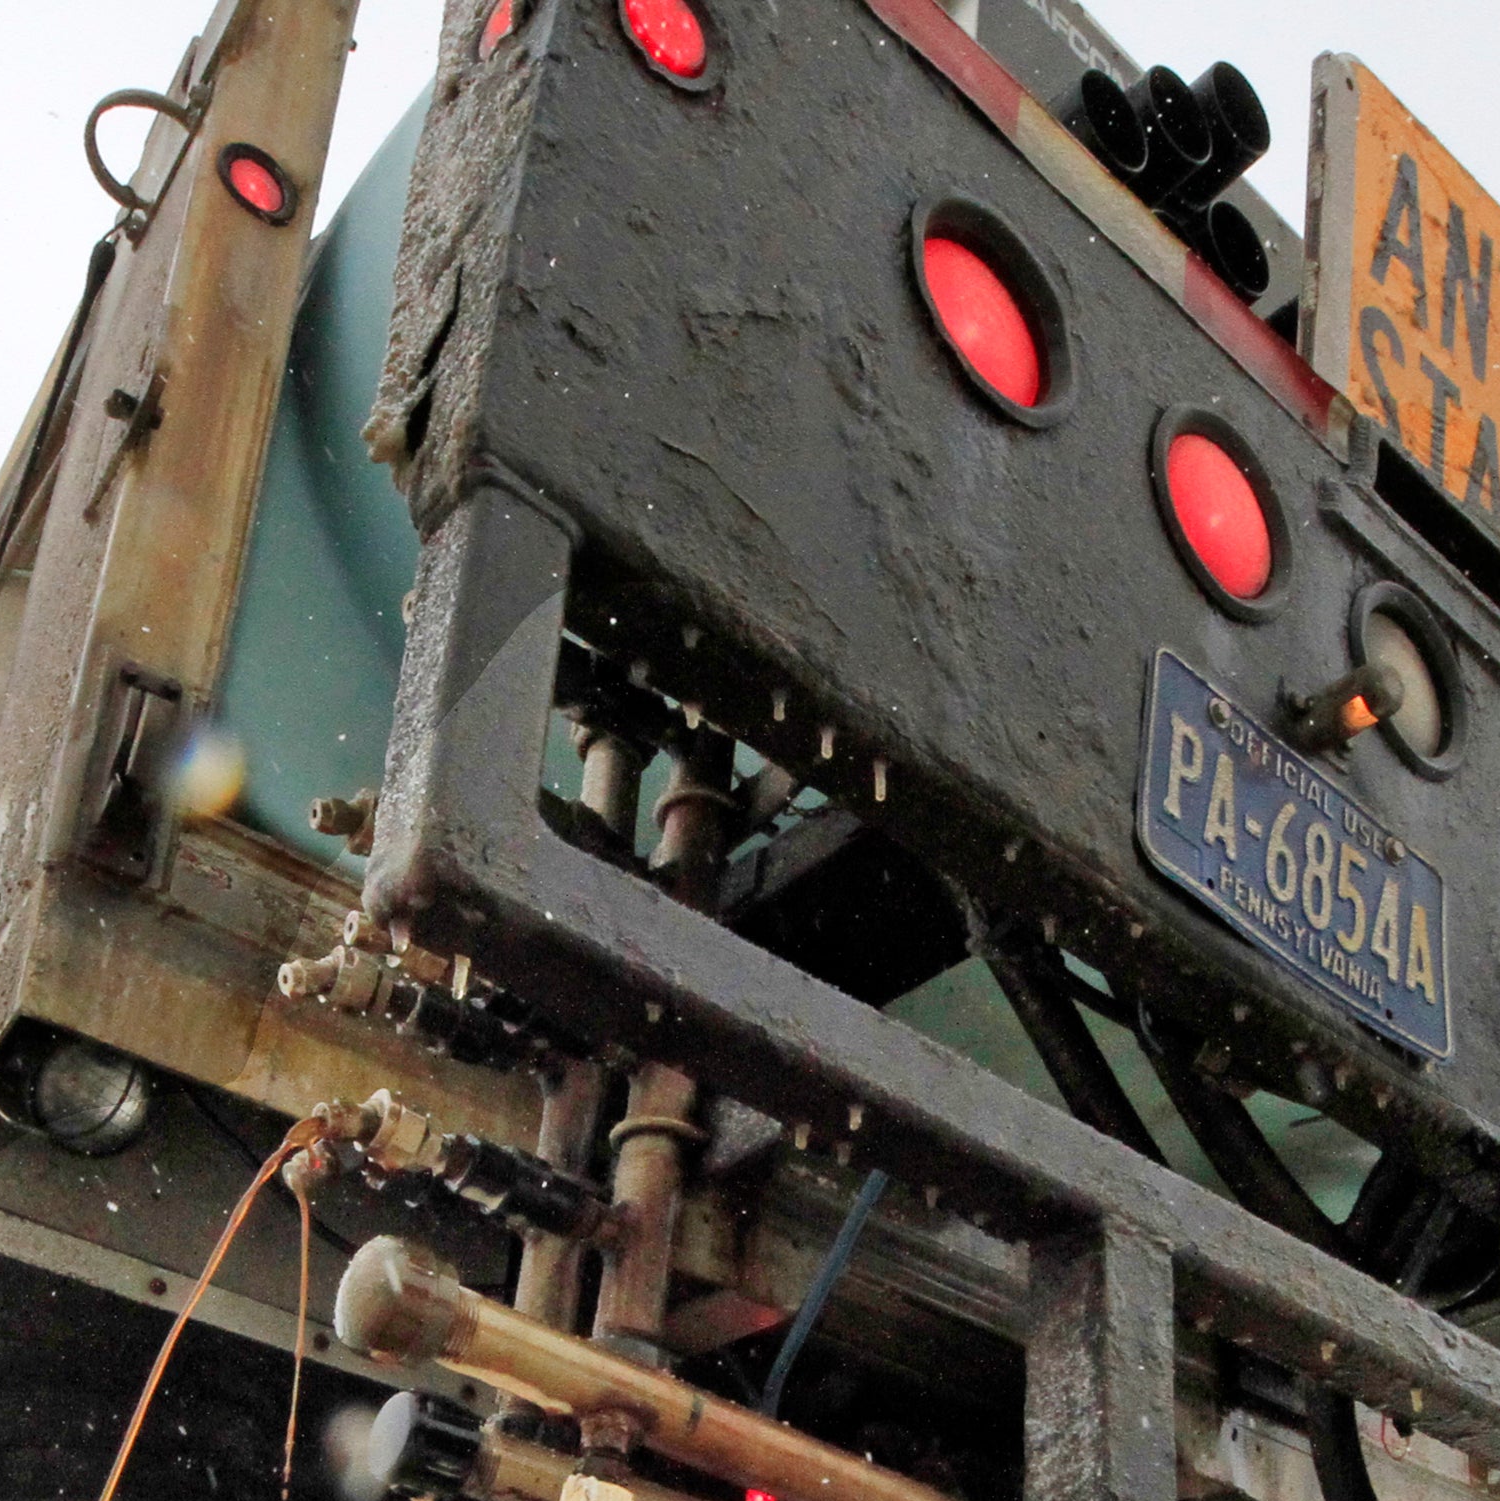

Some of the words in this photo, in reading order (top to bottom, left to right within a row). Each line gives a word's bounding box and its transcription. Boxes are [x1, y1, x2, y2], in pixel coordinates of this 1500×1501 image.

[1163, 712, 1437, 1005] PA-6854A
[1230, 727, 1334, 820] OFFICIAL
[1344, 809, 1383, 858] USE
[1219, 866, 1384, 1007] PENNSYLVANIA
